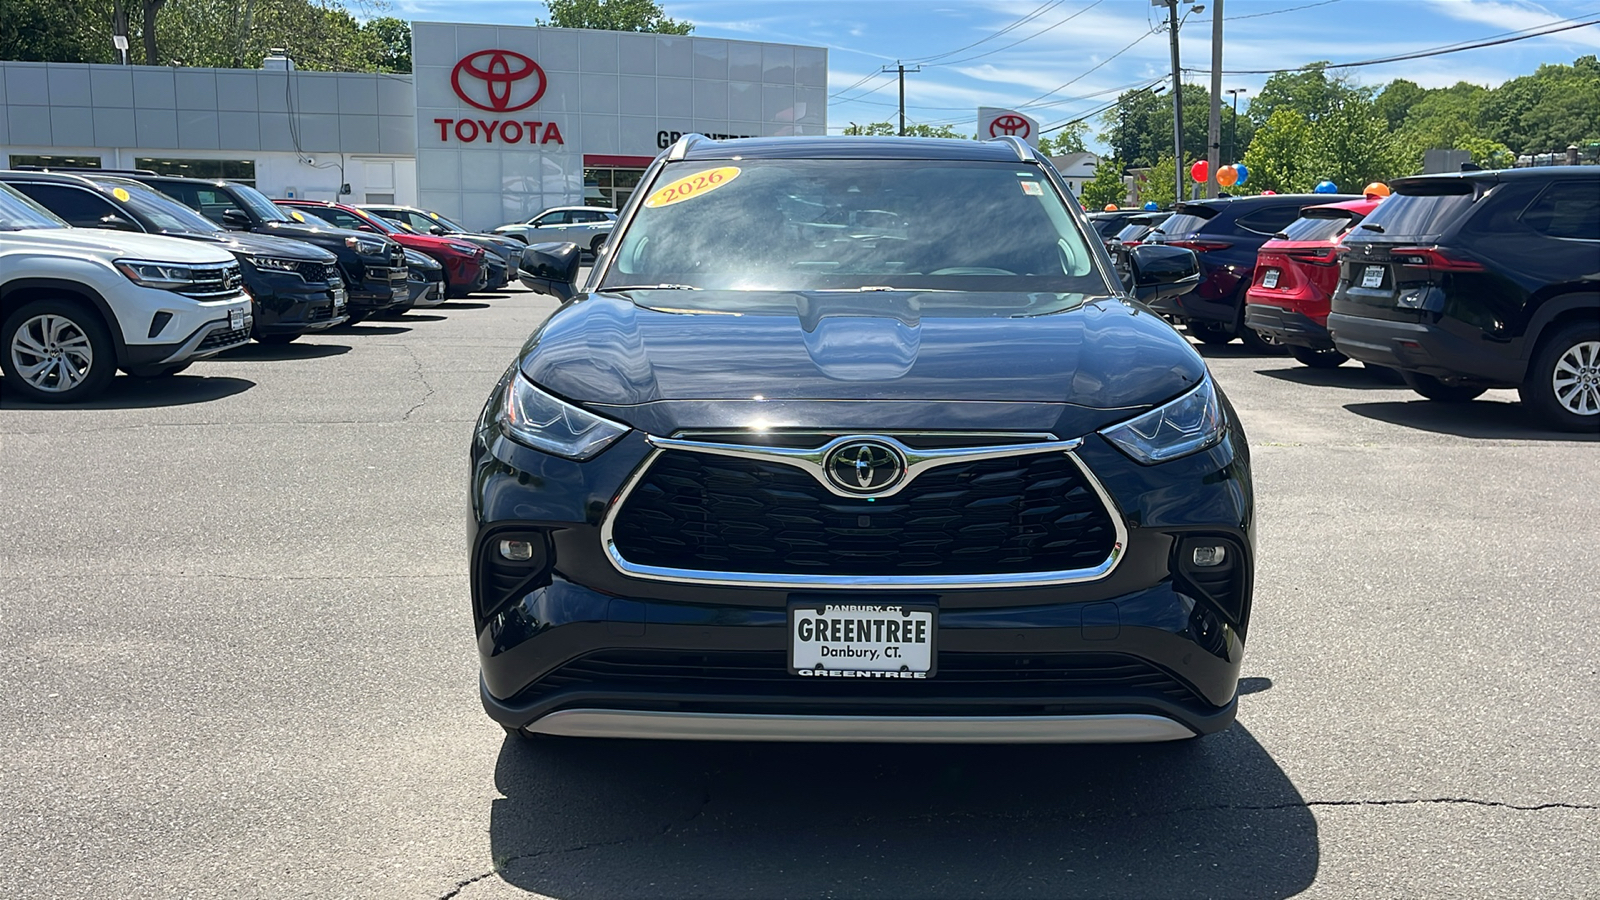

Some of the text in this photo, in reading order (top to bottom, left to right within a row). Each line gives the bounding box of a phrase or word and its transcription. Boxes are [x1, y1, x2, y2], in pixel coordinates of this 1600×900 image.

[434, 118, 565, 145] TOYOTA
[662, 170, 724, 203] 2026
[798, 618, 927, 643] GREENTREE
[821, 645, 902, 661] Danbury, CT.
[798, 669, 927, 679] GREENTREE
